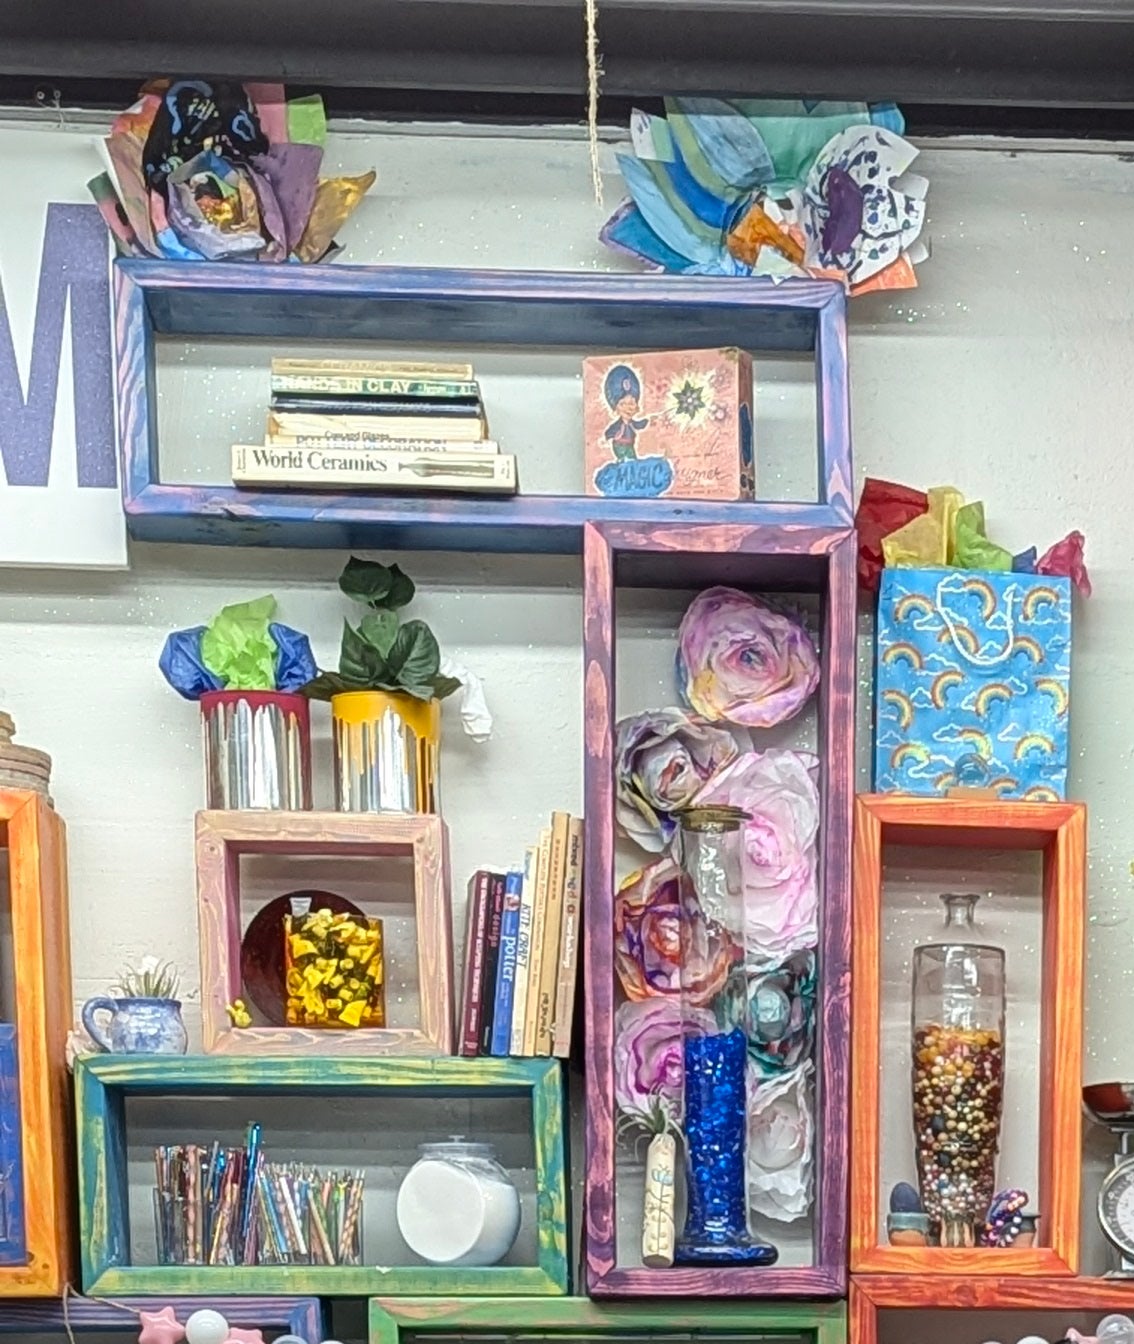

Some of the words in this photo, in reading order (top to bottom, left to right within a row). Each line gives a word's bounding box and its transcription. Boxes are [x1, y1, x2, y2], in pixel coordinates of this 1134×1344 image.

[366, 378, 410, 394] CLAY
[253, 450, 303, 469] World
[307, 451, 388, 472] Ceramics
[612, 463, 664, 491] MAGIC
